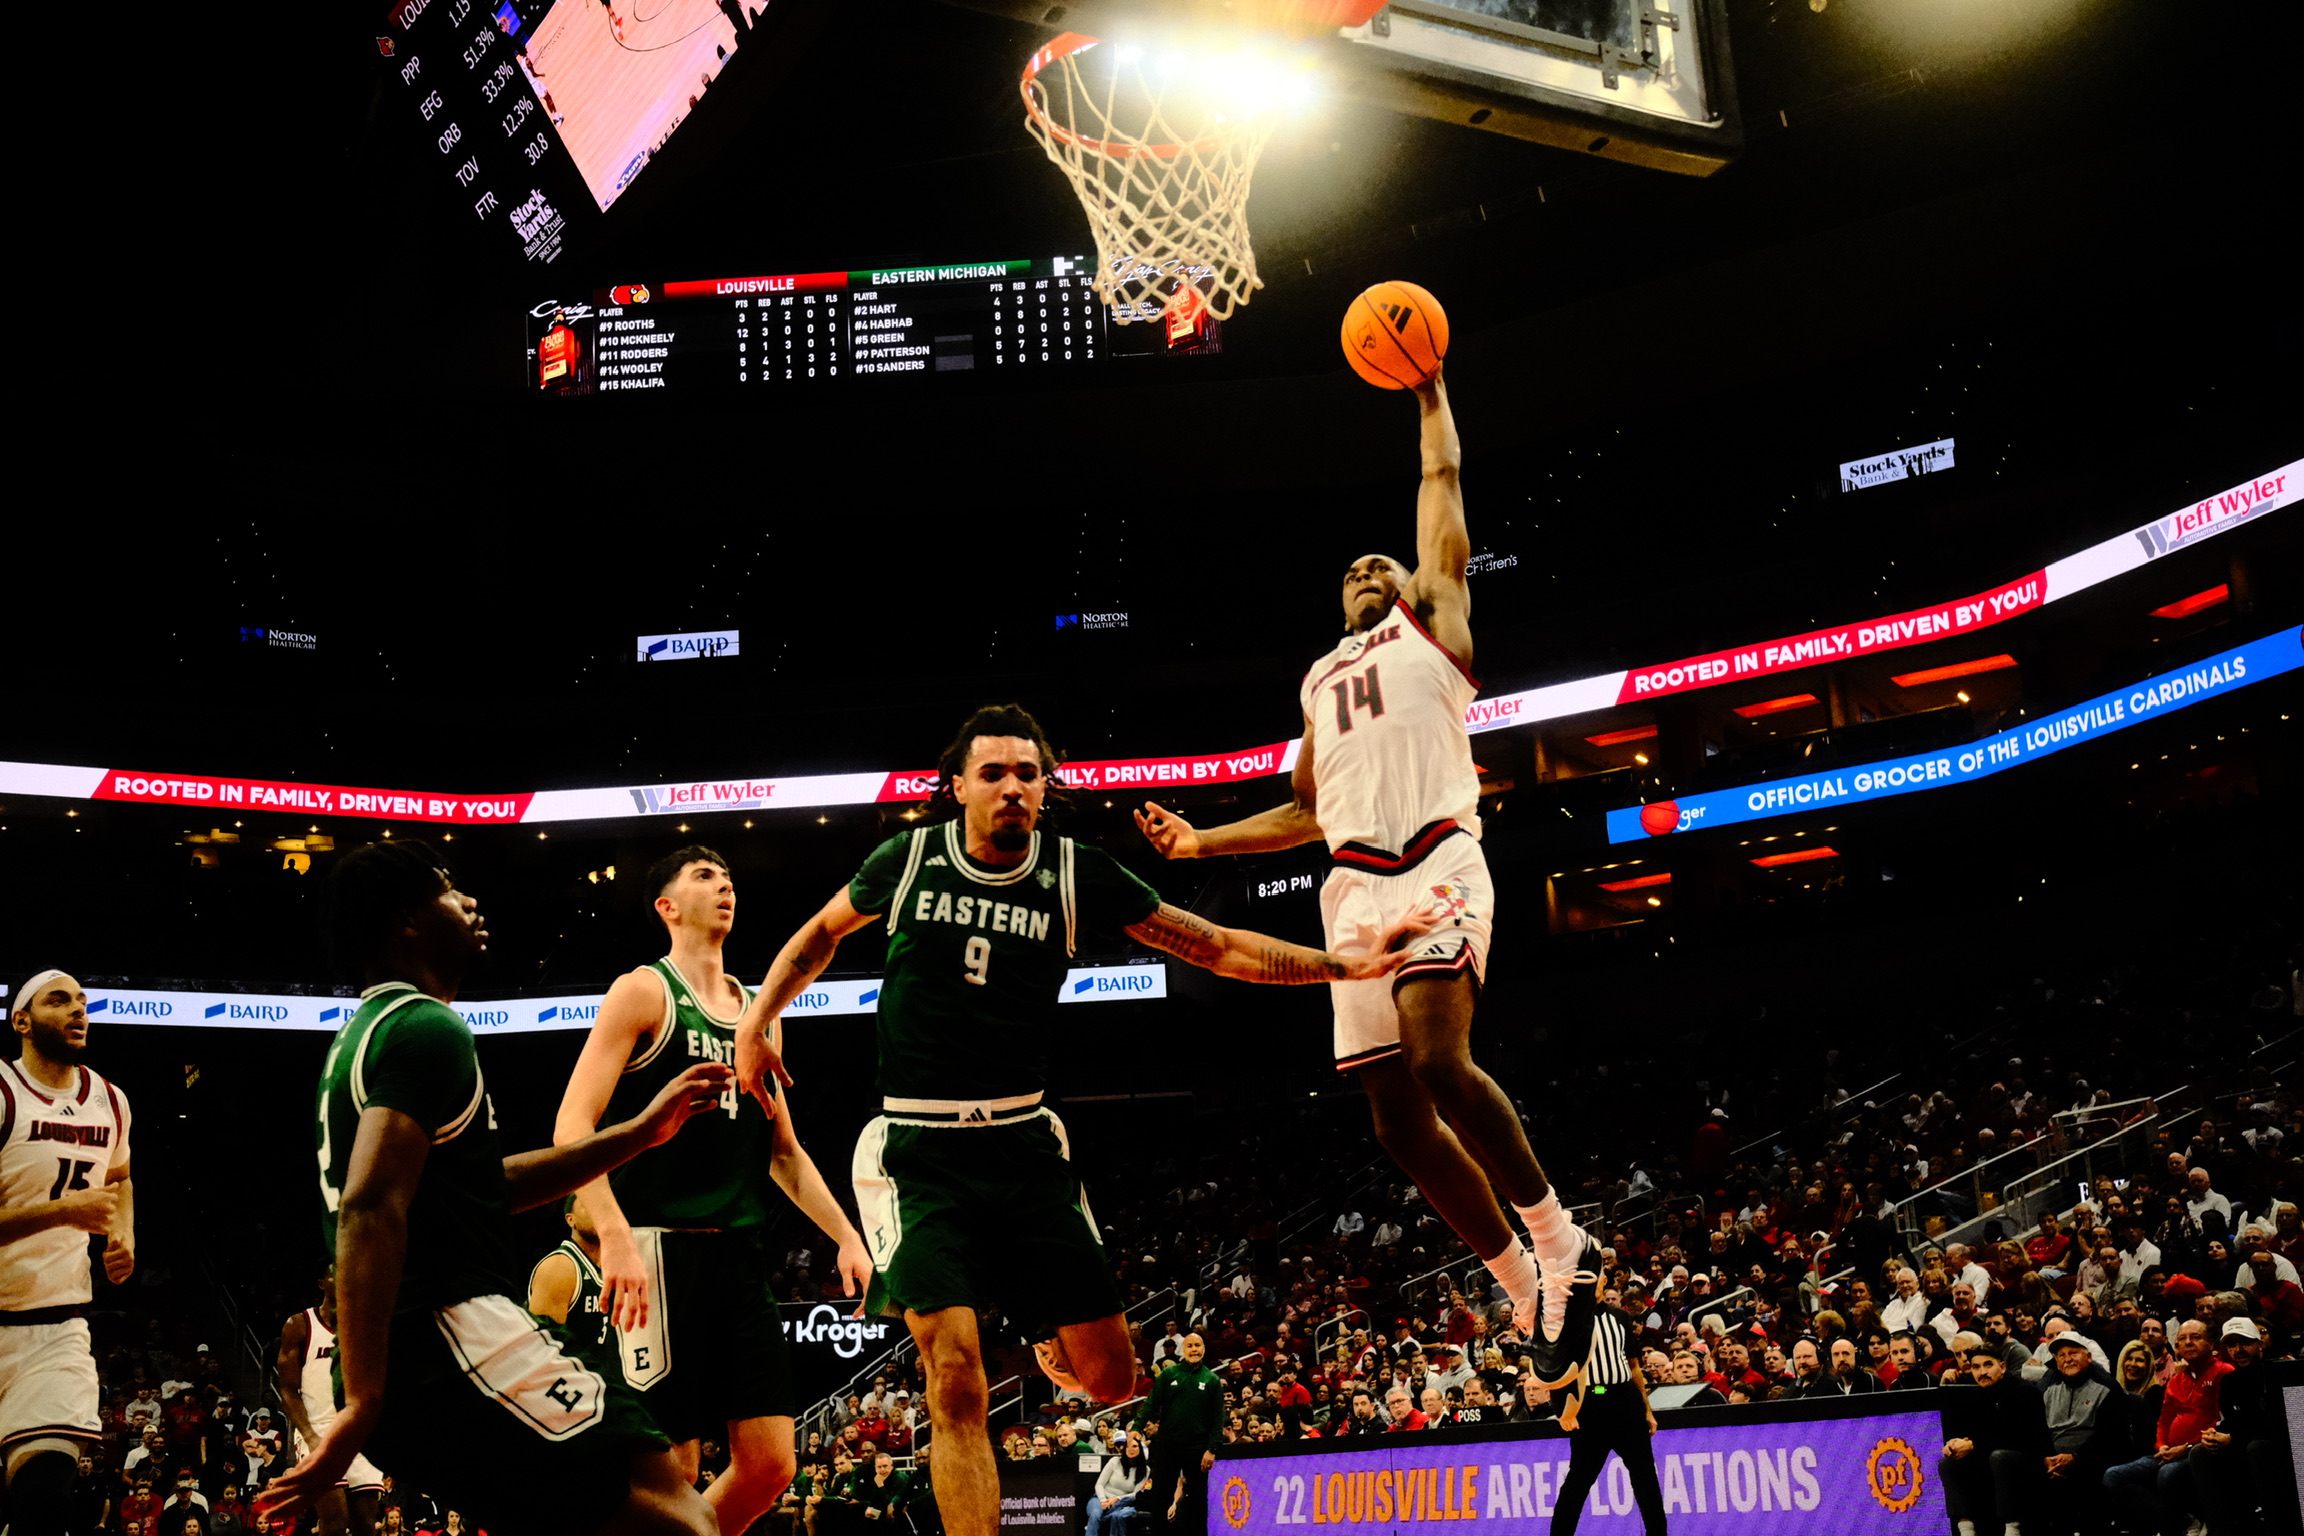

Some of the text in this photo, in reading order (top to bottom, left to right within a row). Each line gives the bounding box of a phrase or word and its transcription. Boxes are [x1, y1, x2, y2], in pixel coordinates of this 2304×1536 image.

[402, 27, 494, 85] PPP 51.3%
[420, 61, 513, 120] EFG 33.3%
[439, 96, 533, 153] ORB 12.3%
[456, 133, 548, 187] TOV 30.8
[475, 192, 498, 220] FTR
[510, 189, 546, 229] Stock
[524, 237, 541, 257] Bank
[544, 214, 563, 235] Trust
[717, 278, 794, 294] LOUISVILLE
[872, 264, 1006, 285] EASTERN MICHIGAN
[854, 277, 1092, 300] PLAYER PTS REB AST STL FLS
[600, 308, 623, 317] PLAYER
[736, 300, 748, 308] PTS
[758, 299, 771, 307] REB
[781, 297, 793, 305] AST
[804, 296, 815, 304] STL
[854, 306, 867, 315] #2
[870, 304, 896, 314] HART
[600, 322, 612, 332] #9
[615, 319, 654, 331] ROOTHS
[855, 318, 912, 330] #4 HABHAB
[600, 337, 618, 346] #10
[621, 333, 674, 345] MCKNEELY
[855, 333, 904, 344] #5 GREEN
[600, 348, 668, 360] #11 RODGERS
[856, 346, 929, 359] #9 PATTERSON
[600, 366, 618, 376] #14
[621, 363, 663, 374] WOOLEY
[856, 361, 924, 373] #10 SANDERS
[600, 378, 664, 390] #15 KHALIFA
[1849, 457, 1896, 478] Stock
[1860, 469, 1900, 486] Bank &
[2174, 475, 2286, 539] Jeff Wyler
[2184, 517, 2237, 544] AUTOMOTIVE FAMILY
[1083, 613, 1128, 622] NORTON
[269, 629, 316, 643] NORTON
[1635, 581, 2038, 693] ROOTED IN FAMILY, DRIVEN BY YOU!
[1329, 663, 1385, 735] 14
[1465, 699, 1523, 726] Wyler
[1748, 657, 2246, 810] OFFICIAL GROCER OF THE LOUISVILLE CARDINALS
[1106, 764, 1186, 782] DRIVEN
[1193, 761, 1220, 778] BY
[1226, 753, 1272, 774] YOU!
[115, 777, 515, 817] ROOTED IN FAMILY, DRIVEN BY YOU!
[669, 782, 775, 806] Jeff Wyler
[1259, 875, 1312, 897] 8:20 PM
[915, 891, 1050, 941] EASTERN
[965, 936, 992, 986] 9
[1097, 976, 1153, 992] BAIRD
[112, 1000, 172, 1018] BAIRD
[786, 993, 829, 1009] AIRD
[230, 1005, 288, 1021] BAIRD
[720, 1076, 738, 1120] 4
[28, 1120, 110, 1149] LOUISVILLE
[50, 1157, 95, 1201] 15
[875, 1225, 887, 1253] E
[796, 1304, 889, 1358] Kroger
[634, 1346, 650, 1371] E
[546, 1377, 583, 1412] E
[1458, 1409, 1482, 1422] POSS
[1274, 1476, 1307, 1524] 22
[1313, 1465, 1479, 1523] LOUISVILLE
[1487, 1460, 1571, 1519] AREA
[1590, 1446, 1821, 1516] LOATIONS
[1000, 1498, 1022, 1510] Official
[1024, 1498, 1039, 1509] Bank
[1040, 1496, 1047, 1508] of
[1001, 1512, 1065, 1525] of Louisville Athletics
